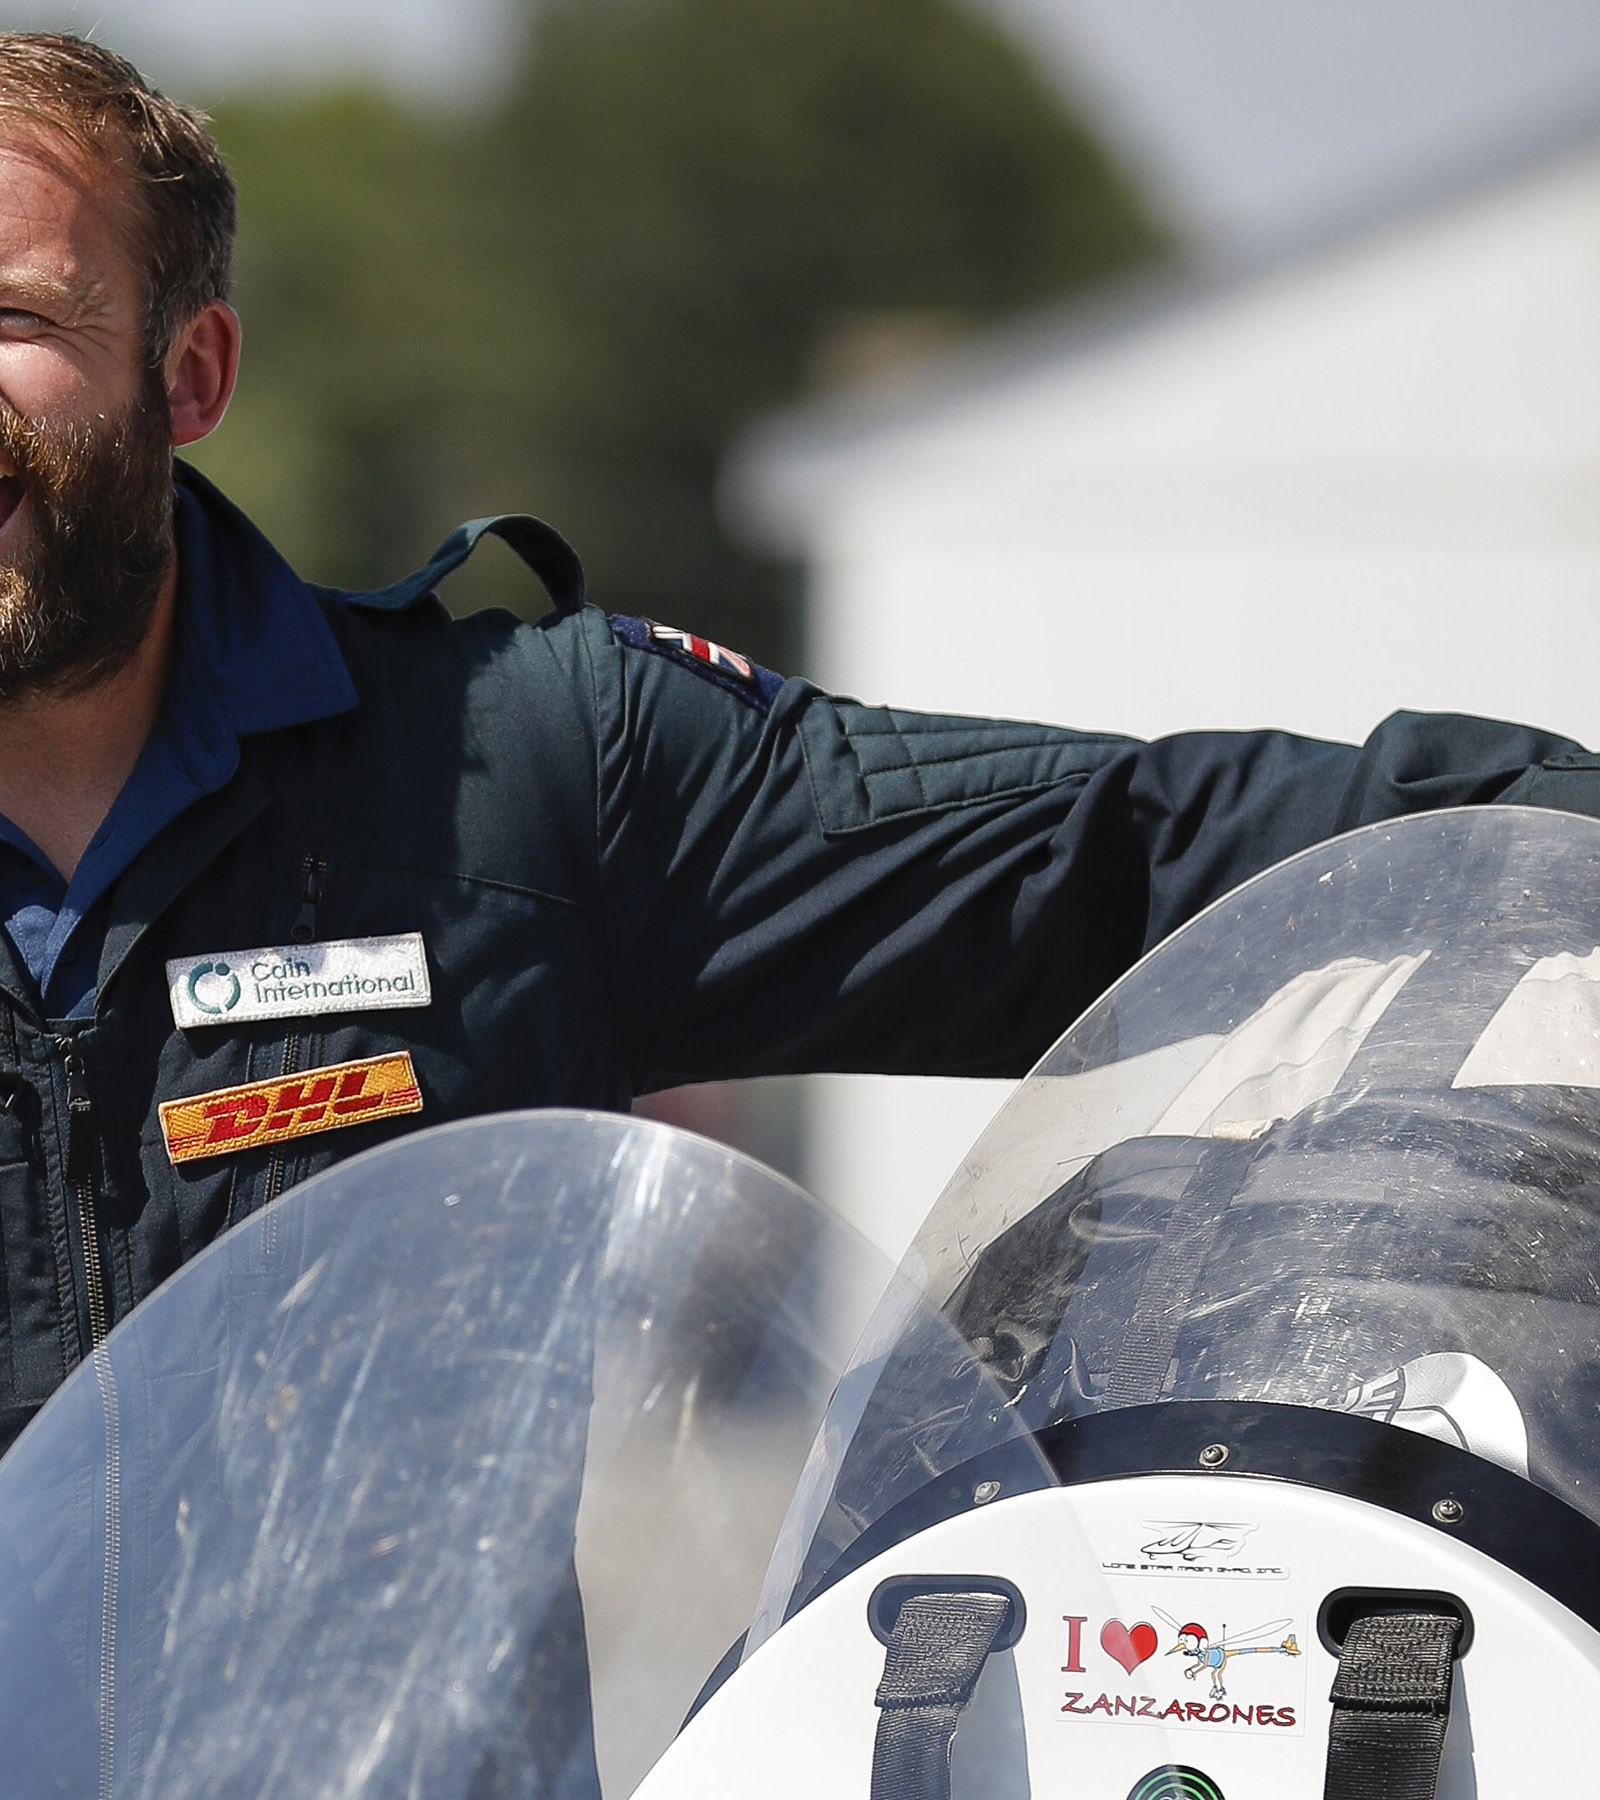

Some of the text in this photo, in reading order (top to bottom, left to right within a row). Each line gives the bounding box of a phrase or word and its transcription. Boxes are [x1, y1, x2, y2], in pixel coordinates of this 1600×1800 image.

[251, 957, 311, 980] Cain
[255, 970, 415, 1003] International
[203, 1070, 384, 1144] DHL
[1061, 1616, 1088, 1673] I
[1061, 1692, 1297, 1727] ZANZARONES
